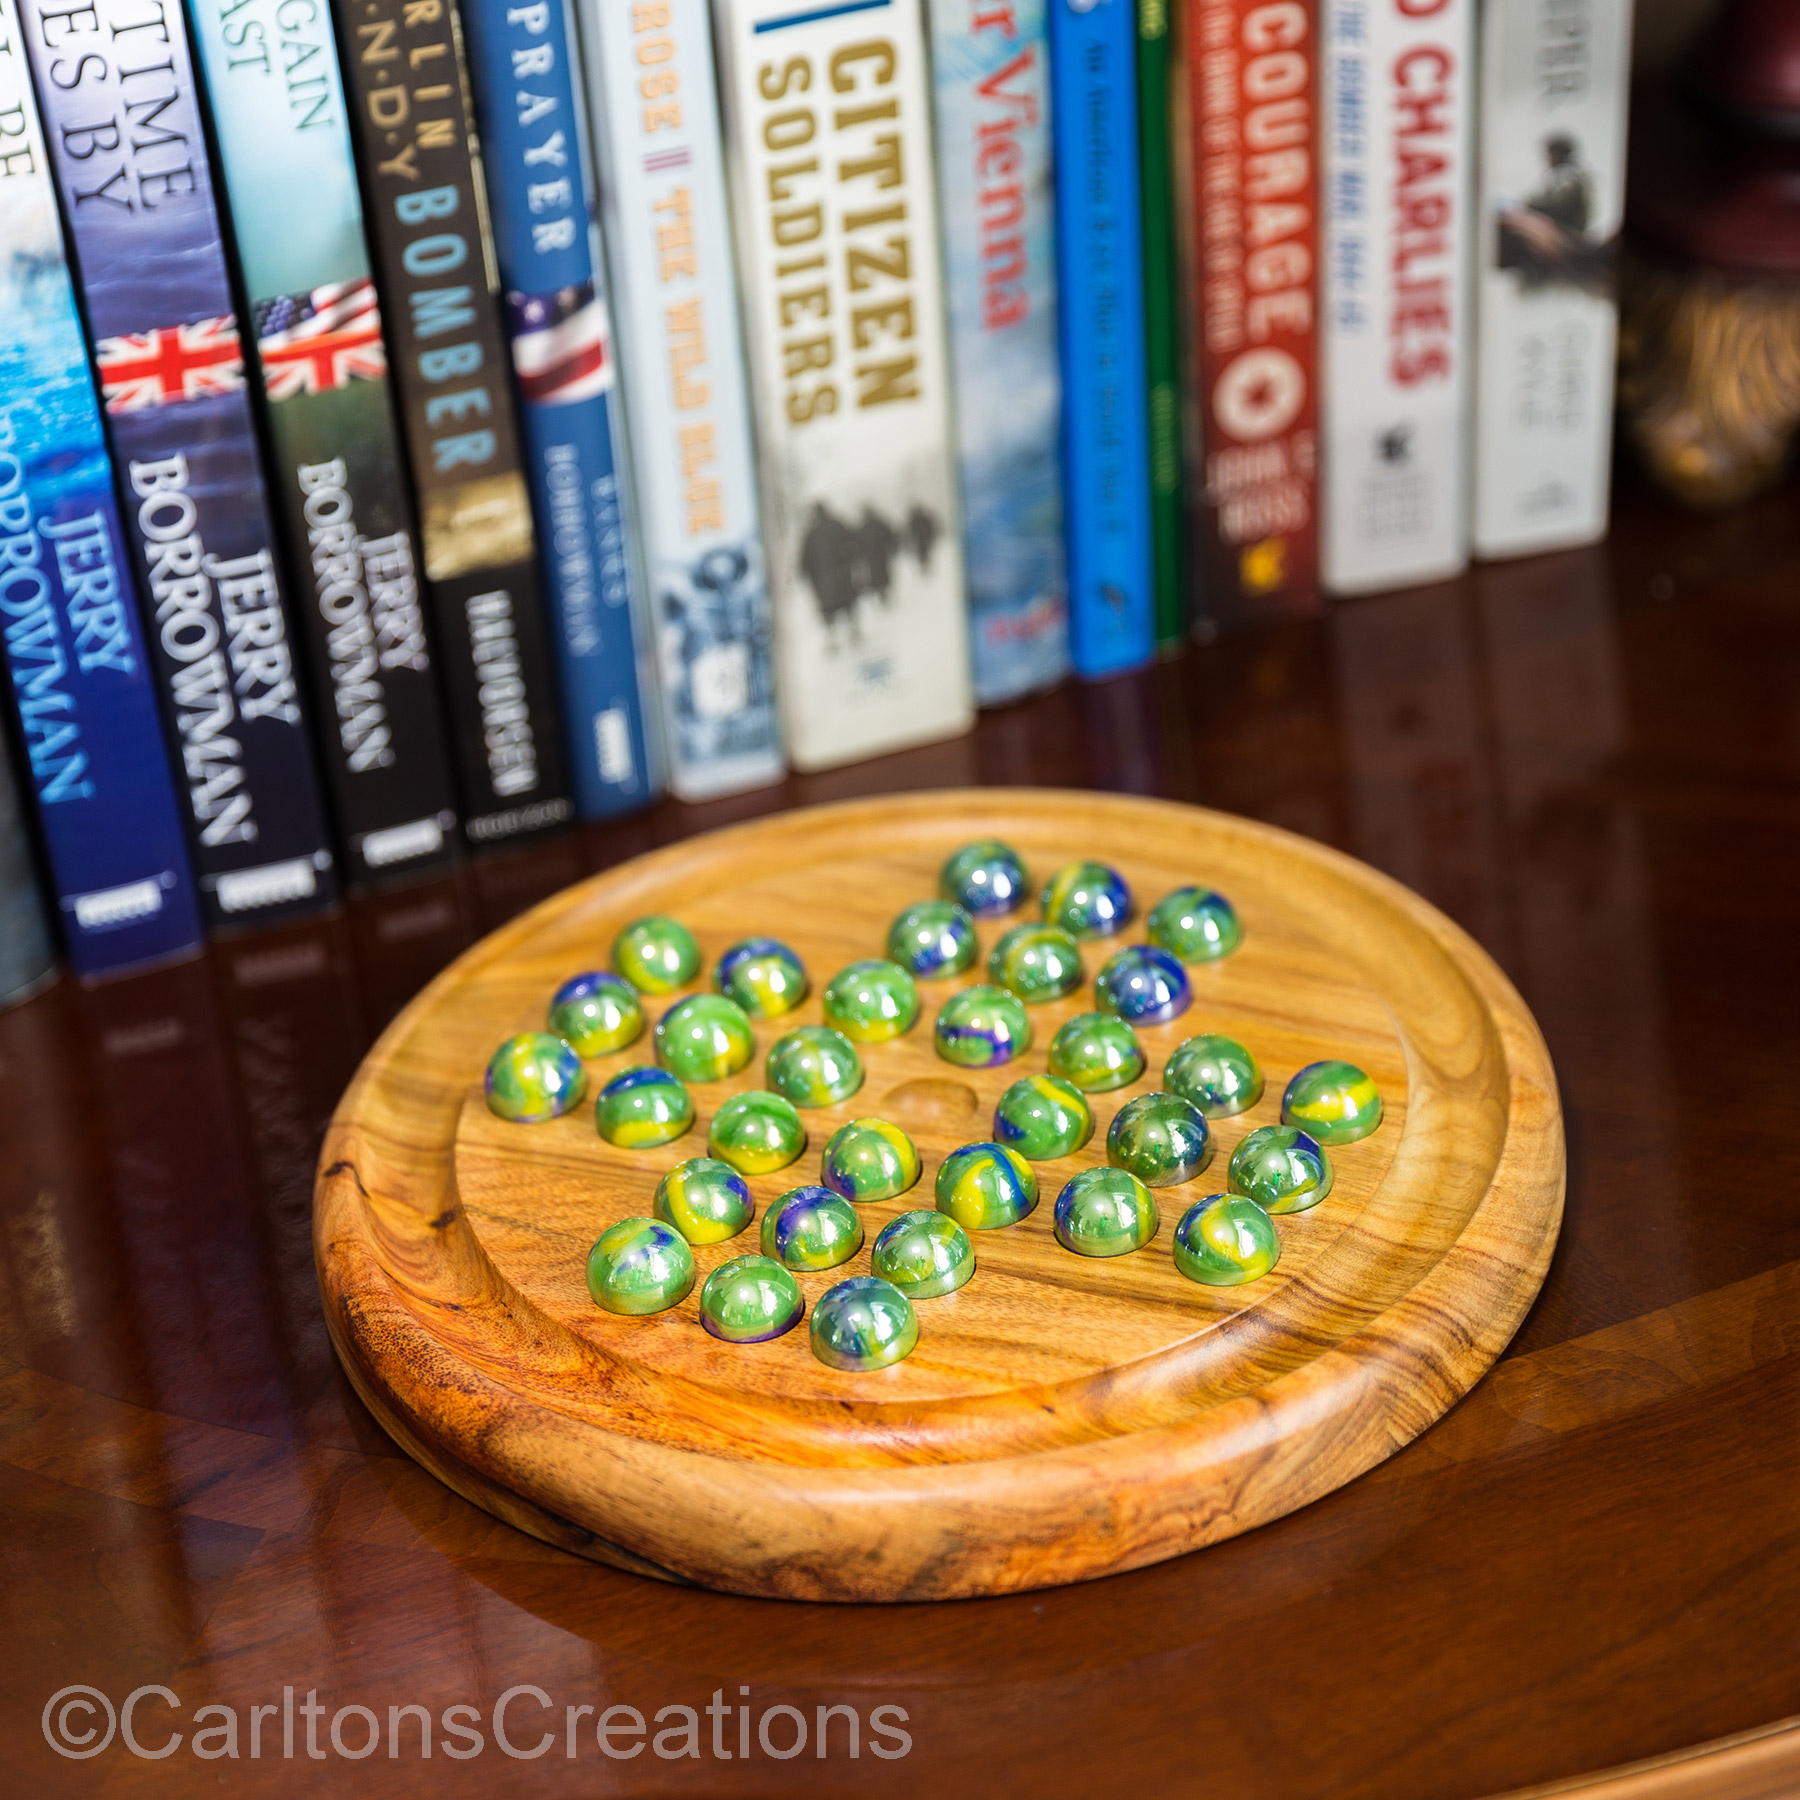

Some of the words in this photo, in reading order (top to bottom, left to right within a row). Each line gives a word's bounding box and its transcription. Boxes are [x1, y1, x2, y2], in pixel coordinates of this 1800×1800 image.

[60, 112, 134, 215] BY
[109, 0, 197, 209] TIME
[275, 0, 336, 132] GAIN
[506, 1, 577, 256] PRAYER
[972, 45, 1038, 334] Vienna
[1241, 1, 1314, 344] COURAGE
[394, 184, 497, 474] BOMBER
[652, 184, 698, 284] THE
[757, 55, 840, 427] SOLDIERS
[828, 36, 922, 412] CITIZEN
[1391, 44, 1456, 390] CHARLIES
[664, 295, 711, 412] WILD
[0, 412, 95, 804] RROWMAN
[37, 507, 137, 676] JERRY
[128, 451, 259, 848] BORROWMAN
[202, 547, 301, 727] JERRY
[297, 456, 396, 774] BORROWMAN
[352, 530, 430, 672] JERRY
